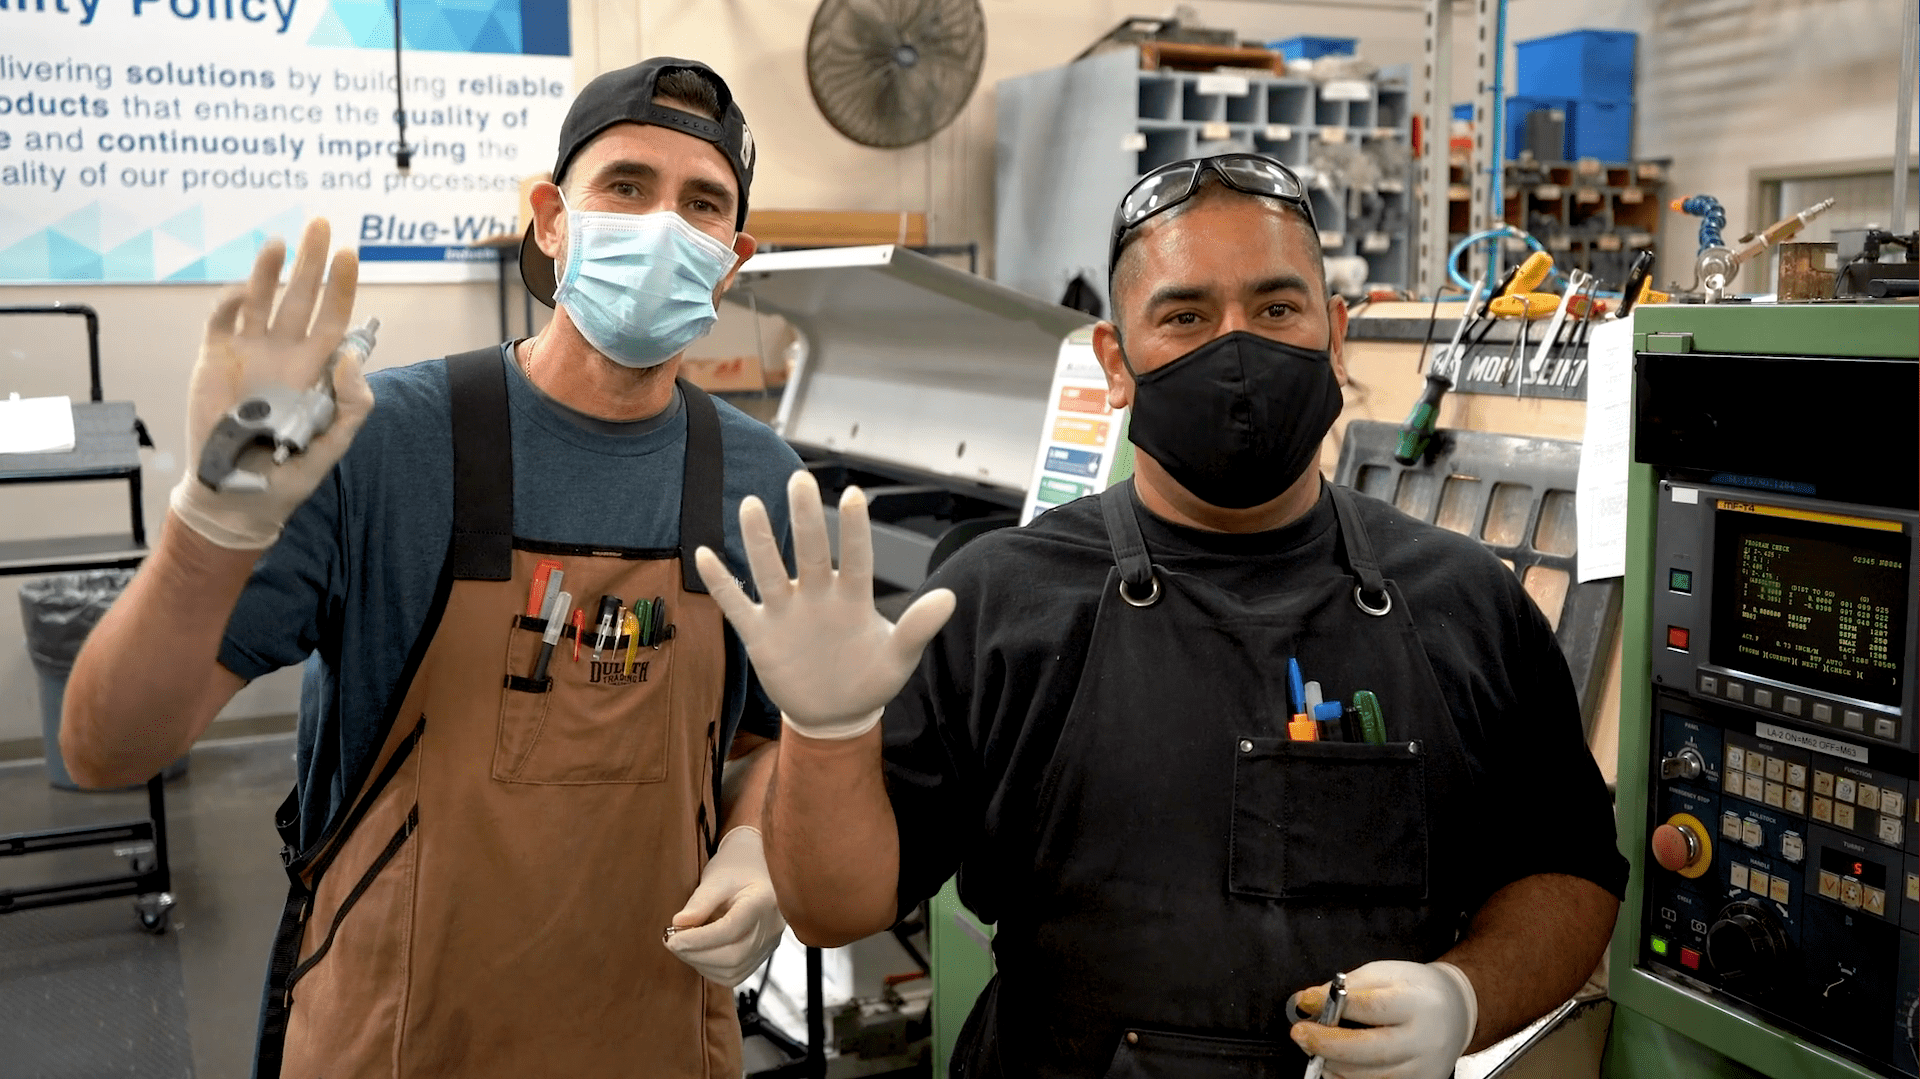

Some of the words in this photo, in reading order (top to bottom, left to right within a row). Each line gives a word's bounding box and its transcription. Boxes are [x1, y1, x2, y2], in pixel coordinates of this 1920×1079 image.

[0, 54, 113, 91] livering
[126, 61, 275, 88] solutions
[288, 67, 321, 95] by
[334, 68, 446, 99] building
[458, 73, 565, 98] reliable
[0, 91, 110, 118] oducts
[122, 94, 181, 120] that
[194, 97, 323, 124] enhance
[336, 103, 379, 124] the
[392, 105, 490, 132] quality
[502, 106, 528, 128] of
[25, 127, 84, 152] and
[97, 127, 304, 162] continuously
[318, 133, 466, 164] improving
[479, 139, 518, 160] the
[2, 159, 66, 193] ality
[80, 160, 107, 187] of
[120, 166, 169, 188] our
[182, 165, 308, 194] products
[321, 168, 372, 190] and
[384, 172, 520, 195] processes
[1745, 539, 1770, 549] PROGRAM
[1772, 543, 1790, 552] CHECK
[1767, 728, 1784, 739] LA-2
[1785, 733, 1817, 748] ON=M62
[1819, 741, 1857, 758] OFF=M63
[1843, 766, 1873, 779] FUNCTION
[1749, 810, 1776, 824] TAILSTOCK
[1750, 858, 1770, 870] HANDLE
